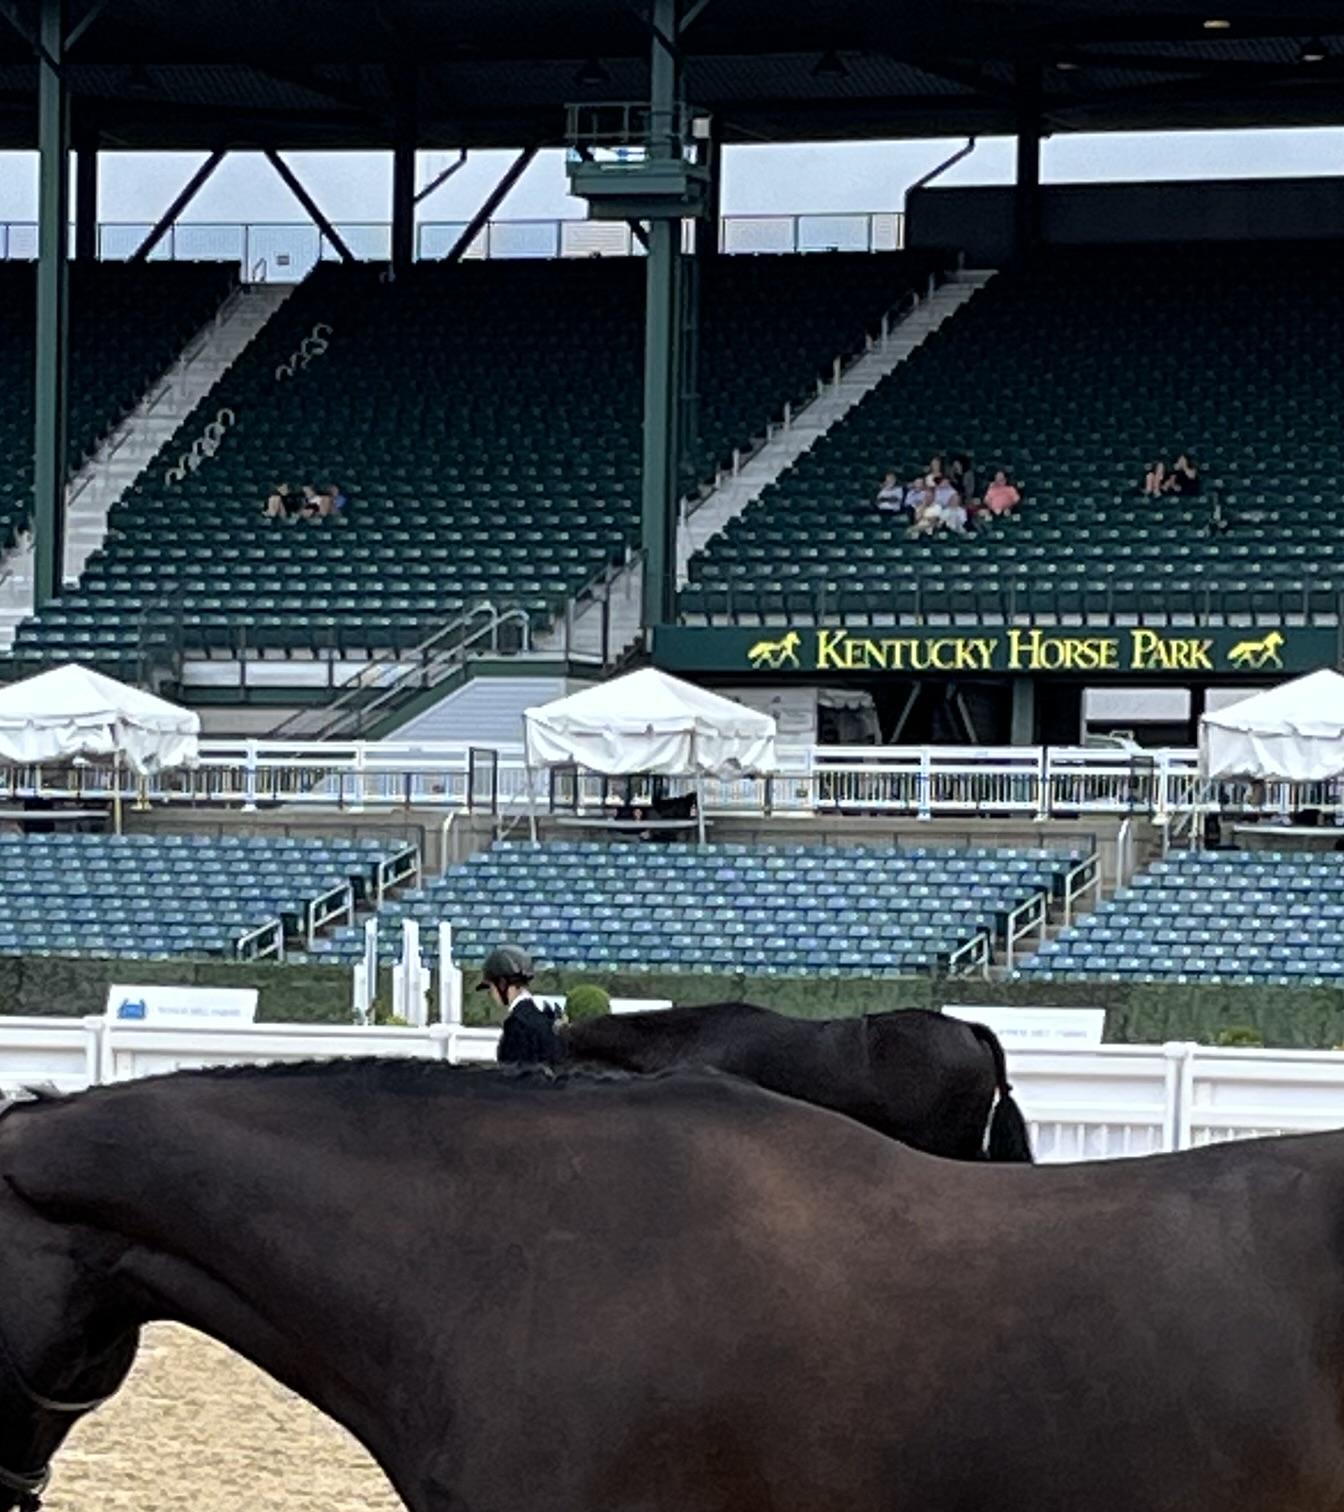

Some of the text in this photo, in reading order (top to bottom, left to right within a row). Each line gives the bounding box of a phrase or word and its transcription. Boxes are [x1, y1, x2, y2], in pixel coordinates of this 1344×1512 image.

[816, 629, 1214, 670] KENTUCKY HORSE PARK
